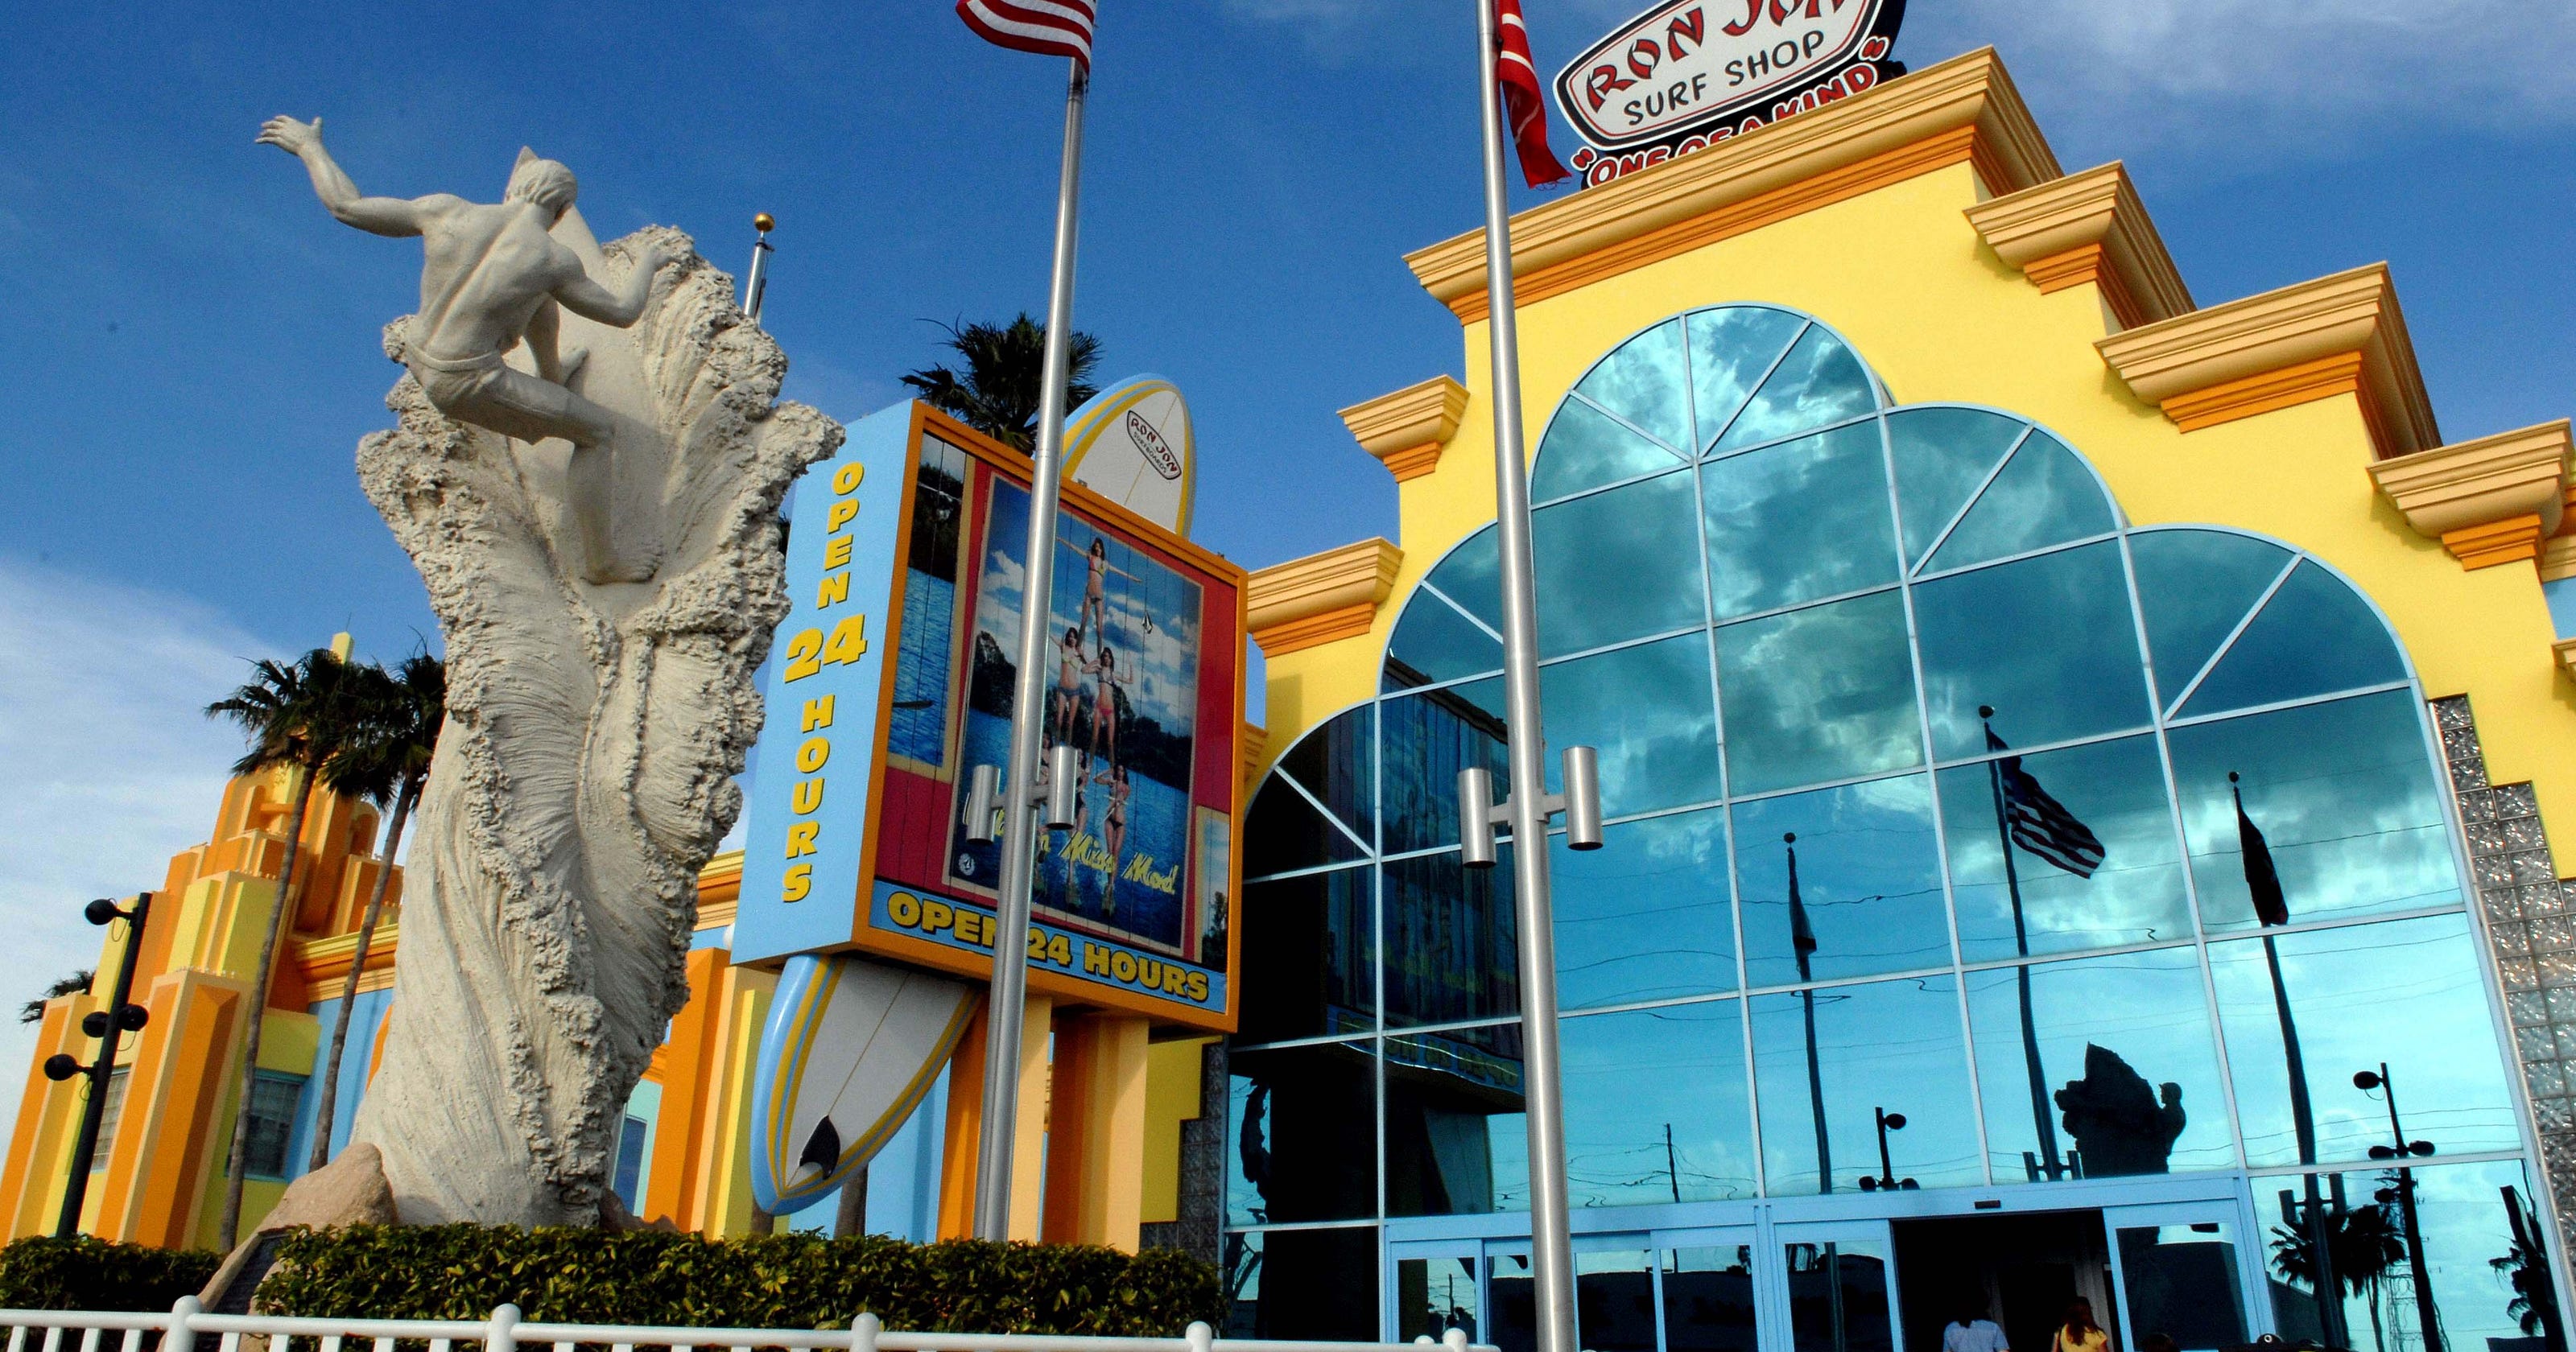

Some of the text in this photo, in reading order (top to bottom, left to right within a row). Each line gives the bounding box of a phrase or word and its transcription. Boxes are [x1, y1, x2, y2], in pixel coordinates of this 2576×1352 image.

[1586, 6, 1705, 113] RON
[1623, 30, 1825, 126] SURF SHOP
[1130, 418, 1178, 472] RON JON
[1133, 431, 1167, 473] SURFBOARDS
[782, 461, 868, 904] OPEN 24 HOURS
[1058, 830, 1179, 896] Miss Mod
[1027, 926, 1072, 967] 24
[1083, 941, 1209, 1003] HOURS
